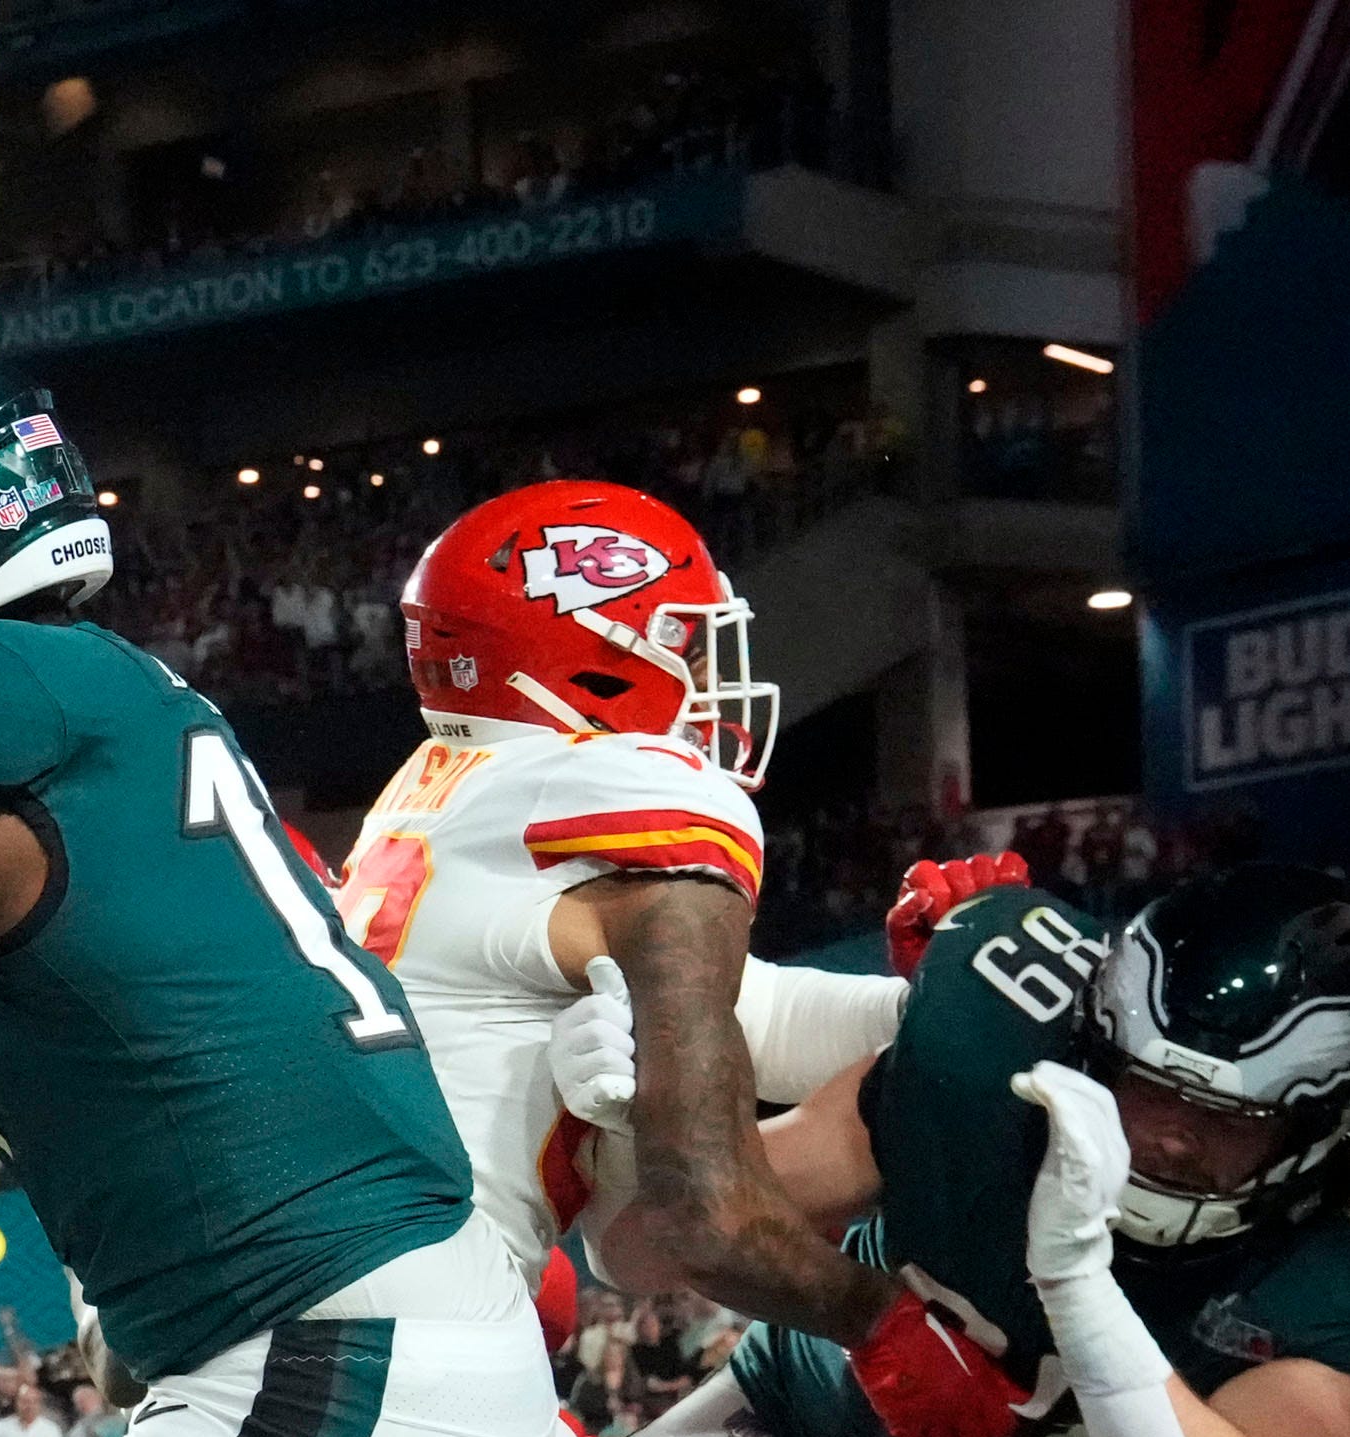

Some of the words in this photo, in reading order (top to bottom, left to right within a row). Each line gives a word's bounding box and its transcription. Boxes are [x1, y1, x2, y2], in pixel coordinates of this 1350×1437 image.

[0, 307, 82, 350] AND
[87, 268, 286, 338] LOCATION
[290, 258, 352, 298] TO
[362, 197, 658, 287] 623-400-2210
[51, 536, 108, 567] CHOOSE
[436, 723, 472, 738] LOVE
[189, 735, 407, 1039] 1
[972, 906, 1111, 1023] 68
